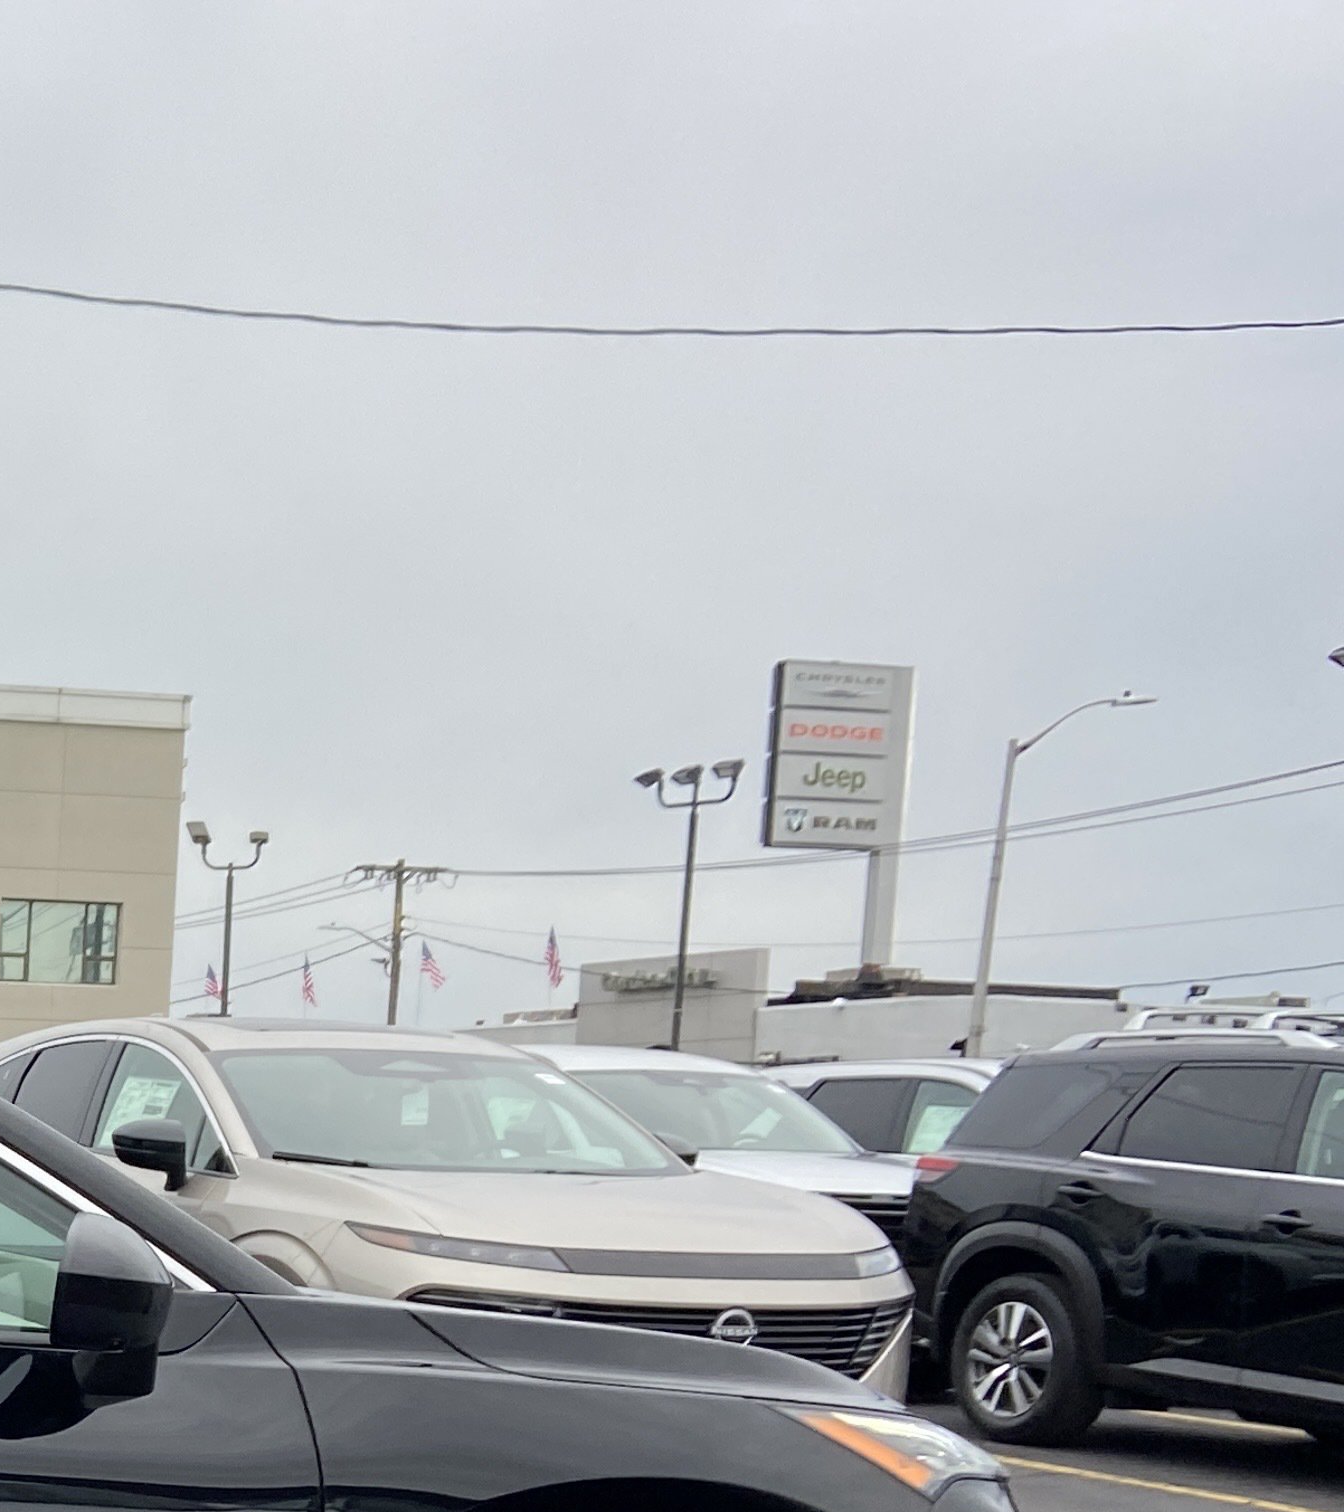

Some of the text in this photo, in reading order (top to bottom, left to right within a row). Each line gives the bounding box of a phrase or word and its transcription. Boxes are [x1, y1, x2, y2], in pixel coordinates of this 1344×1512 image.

[795, 672, 887, 686] CHRYSLER
[788, 723, 885, 741] DODGE
[802, 761, 867, 794] Jeep
[812, 815, 878, 831] RAM
